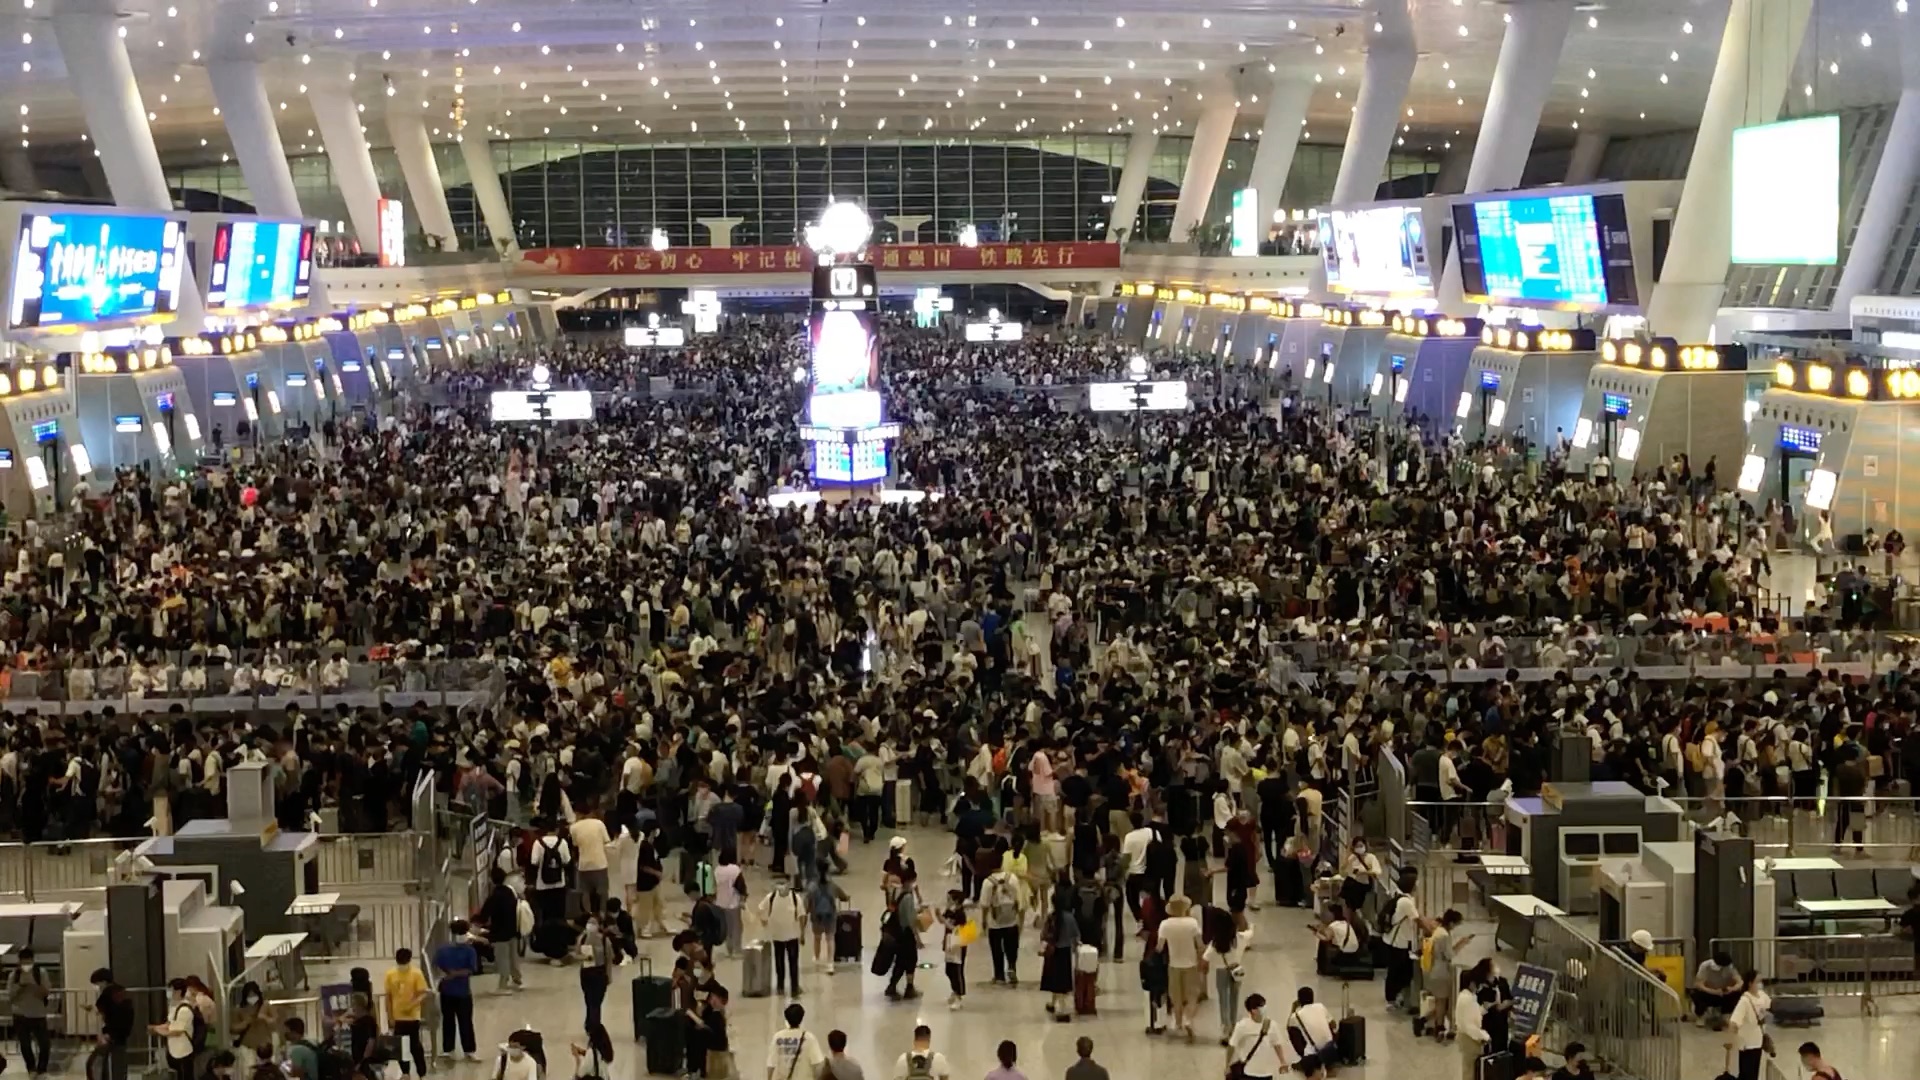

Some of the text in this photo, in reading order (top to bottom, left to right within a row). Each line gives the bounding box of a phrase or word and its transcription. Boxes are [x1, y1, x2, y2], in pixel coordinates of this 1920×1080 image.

[607, 251, 703, 271] 不忘初心
[732, 251, 801, 270] 牢记使
[980, 245, 1074, 267] 铁路先行
